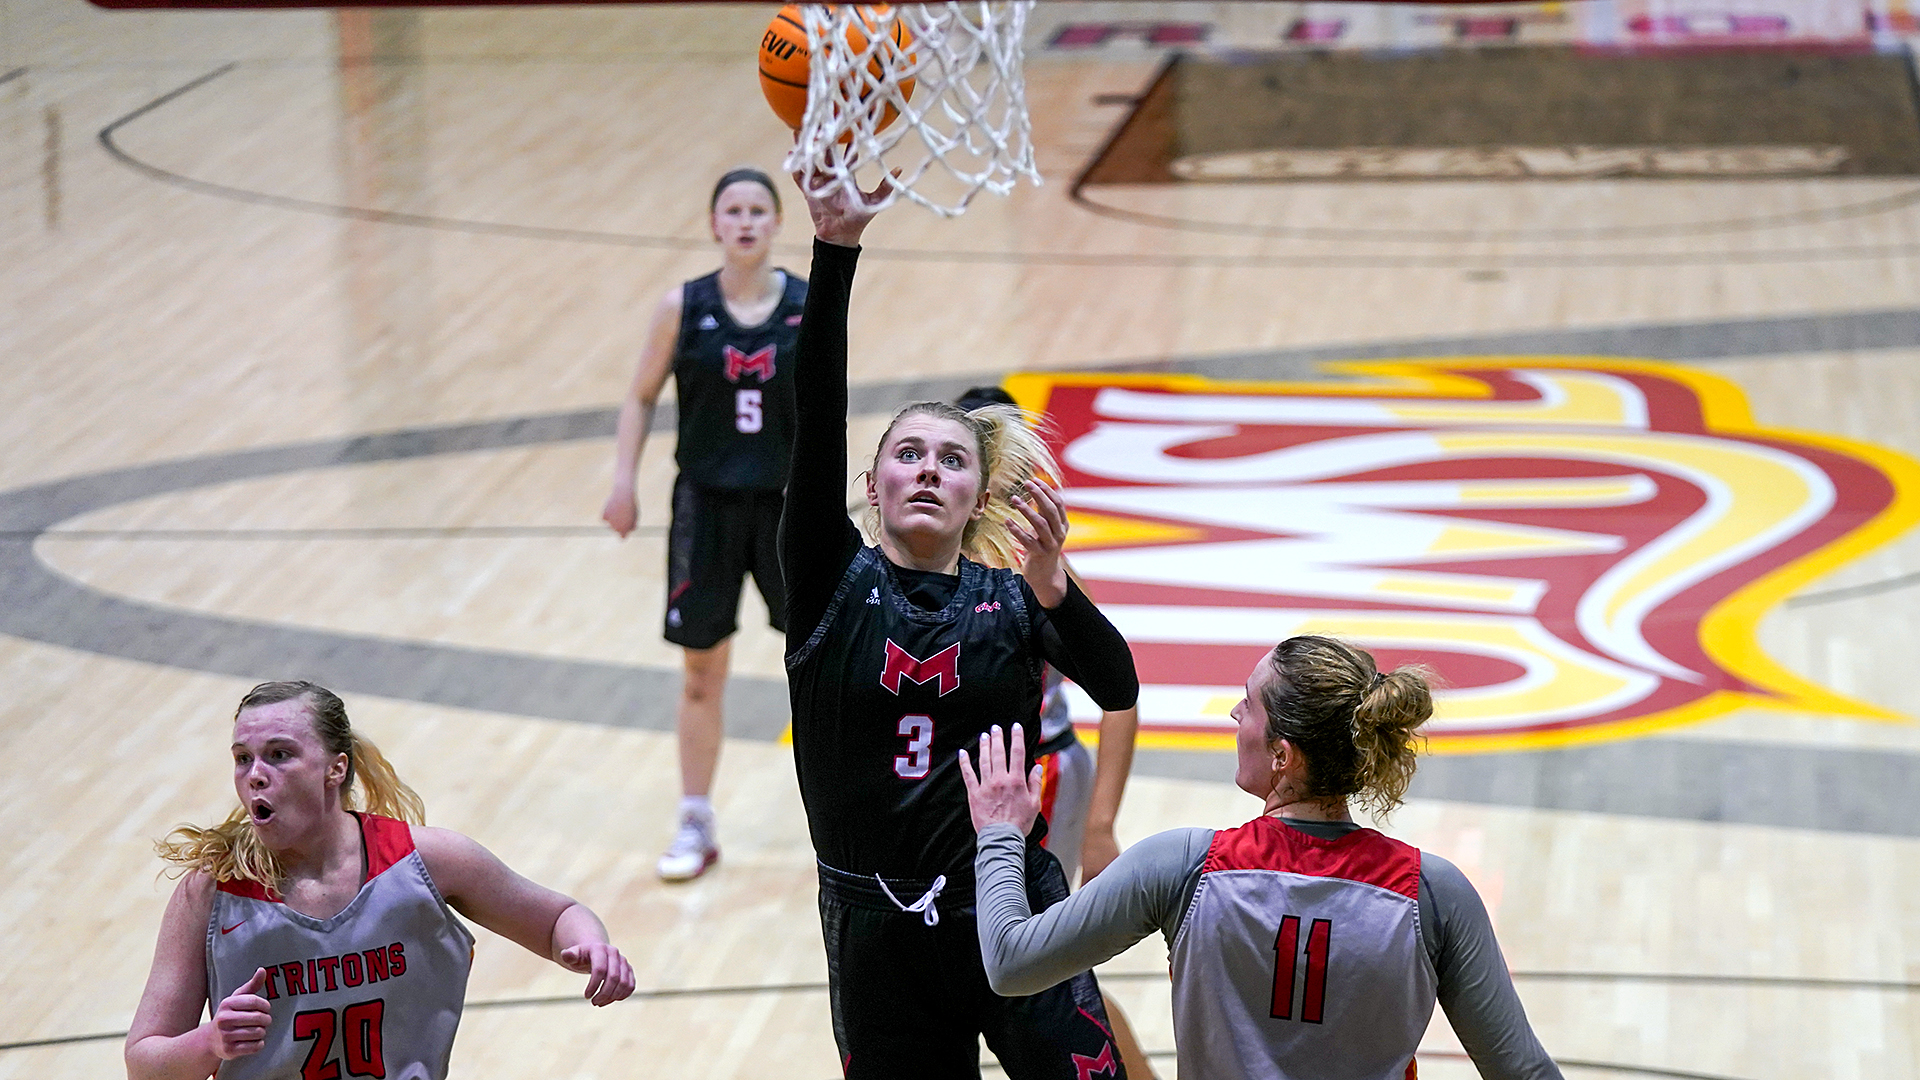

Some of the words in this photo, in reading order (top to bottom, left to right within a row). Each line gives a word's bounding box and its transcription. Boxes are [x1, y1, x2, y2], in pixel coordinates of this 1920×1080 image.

[761, 29, 797, 60] EVO
[722, 343, 777, 384] M
[735, 389, 763, 434] 5
[880, 638, 961, 698] M
[893, 713, 935, 780] 3
[264, 942, 407, 1000] TRITONS
[1270, 914, 1332, 1024] 11
[293, 998, 386, 1080] 20
